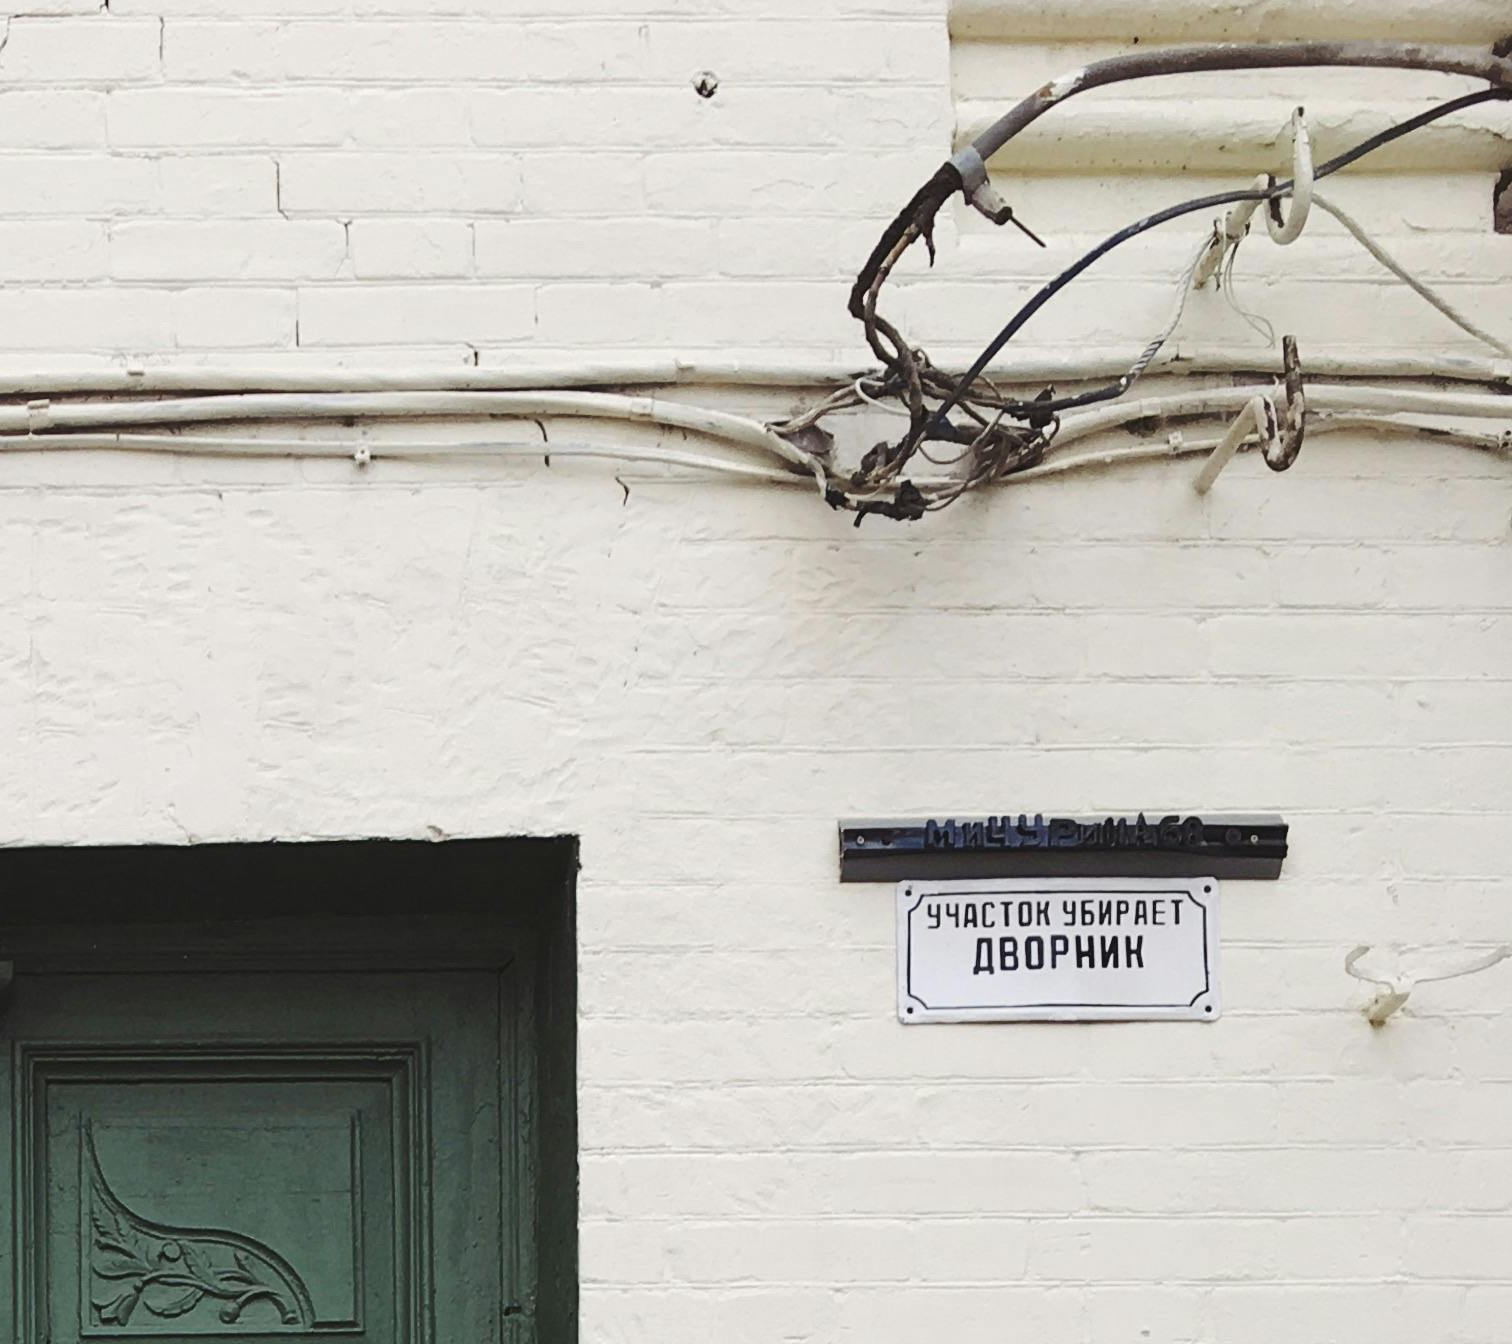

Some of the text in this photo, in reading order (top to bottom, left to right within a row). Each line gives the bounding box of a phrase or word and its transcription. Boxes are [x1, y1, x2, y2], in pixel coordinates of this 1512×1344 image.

[926, 898, 1184, 930] УЧАСТОК УБИРАЕТ
[972, 934, 1145, 976] ДВОРНИК
